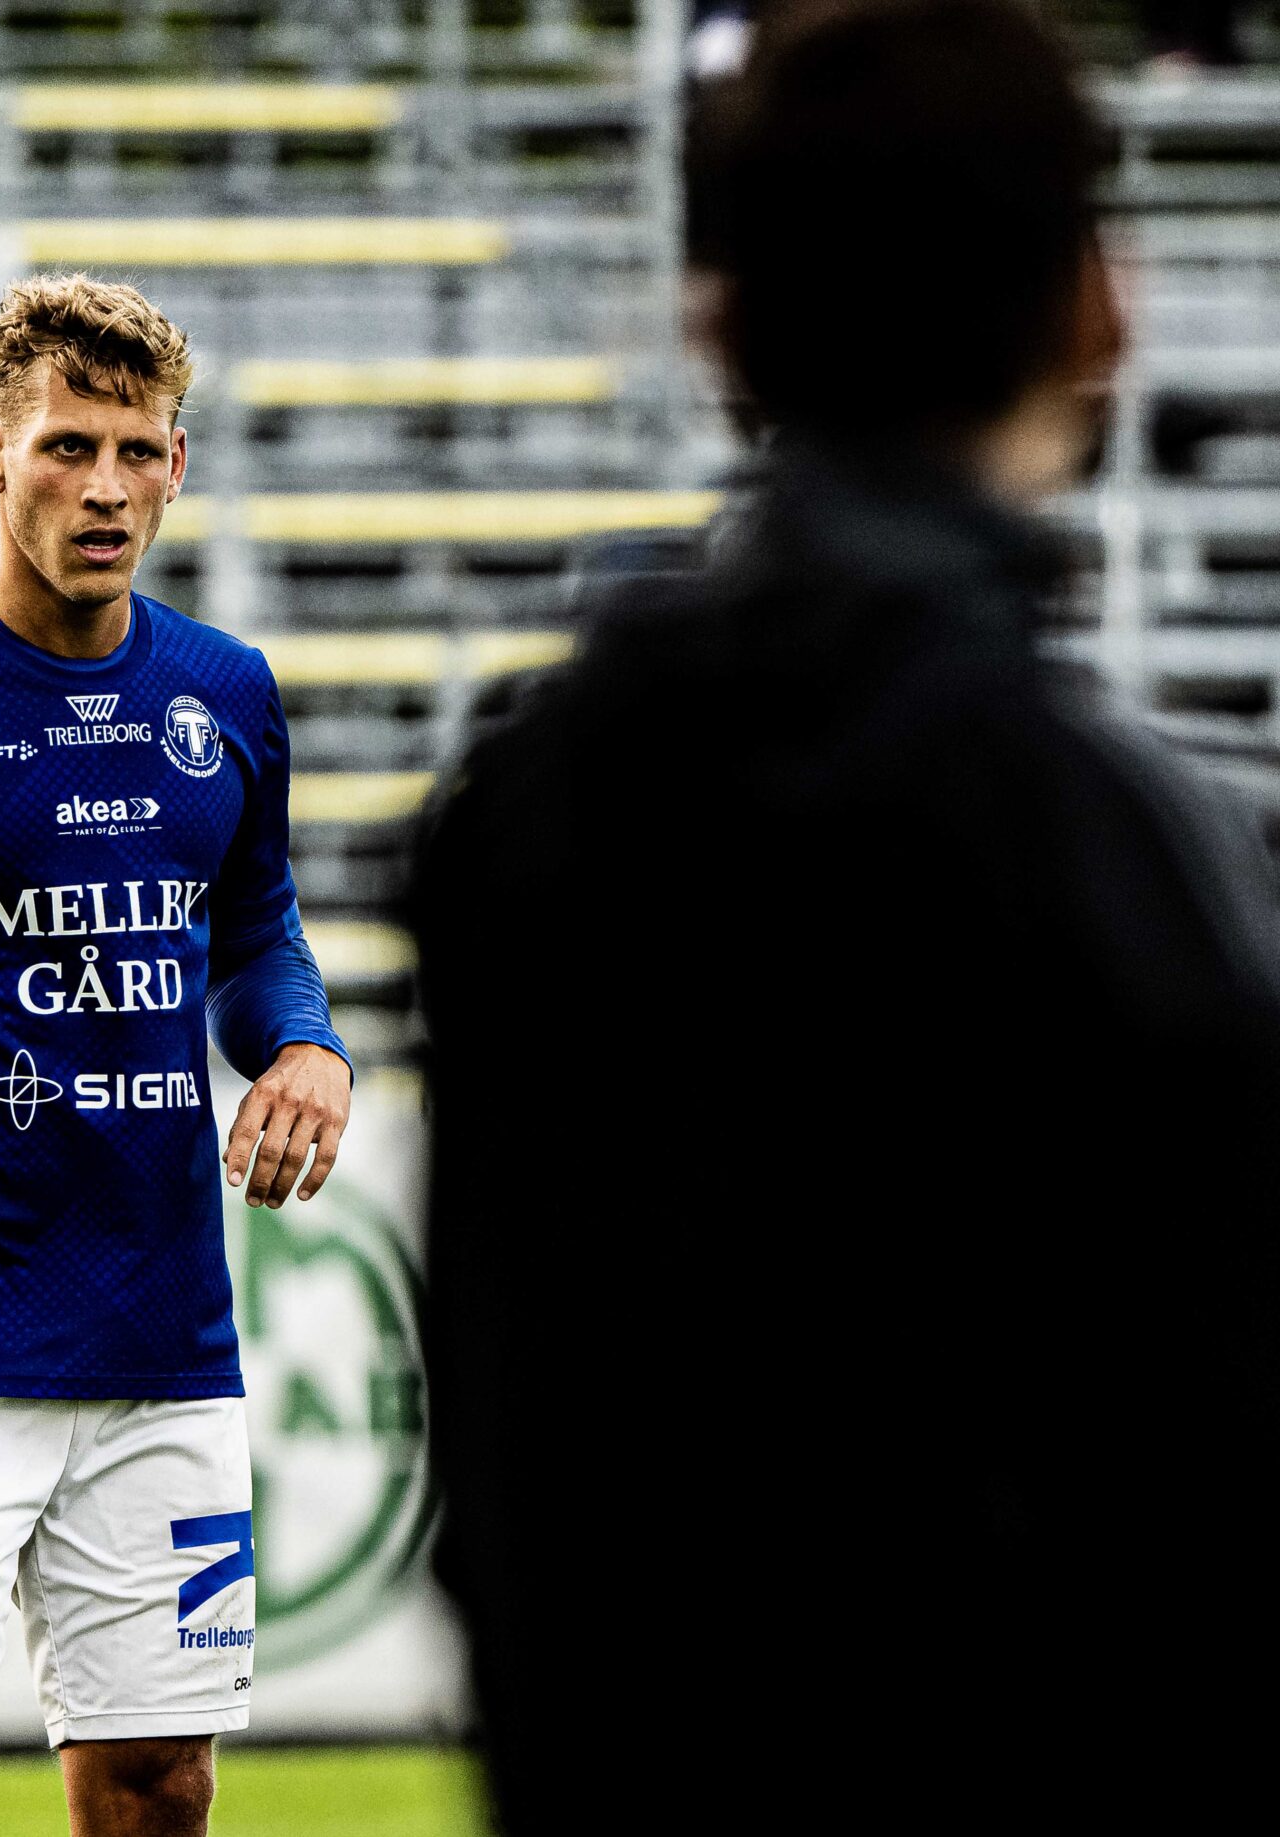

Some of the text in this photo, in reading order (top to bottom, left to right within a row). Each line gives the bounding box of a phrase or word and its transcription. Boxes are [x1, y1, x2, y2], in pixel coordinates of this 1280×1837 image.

[44, 723, 152, 746] TRELLEBORG
[160, 737, 221, 778] TRELLEBORGS
[56, 795, 128, 824] akea
[75, 828, 94, 836] PART
[96, 827, 107, 835] OF
[18, 945, 182, 1015] GÅRD
[74, 1072, 201, 1109] SIGMA
[177, 1626, 255, 1649] Trelleborgs
